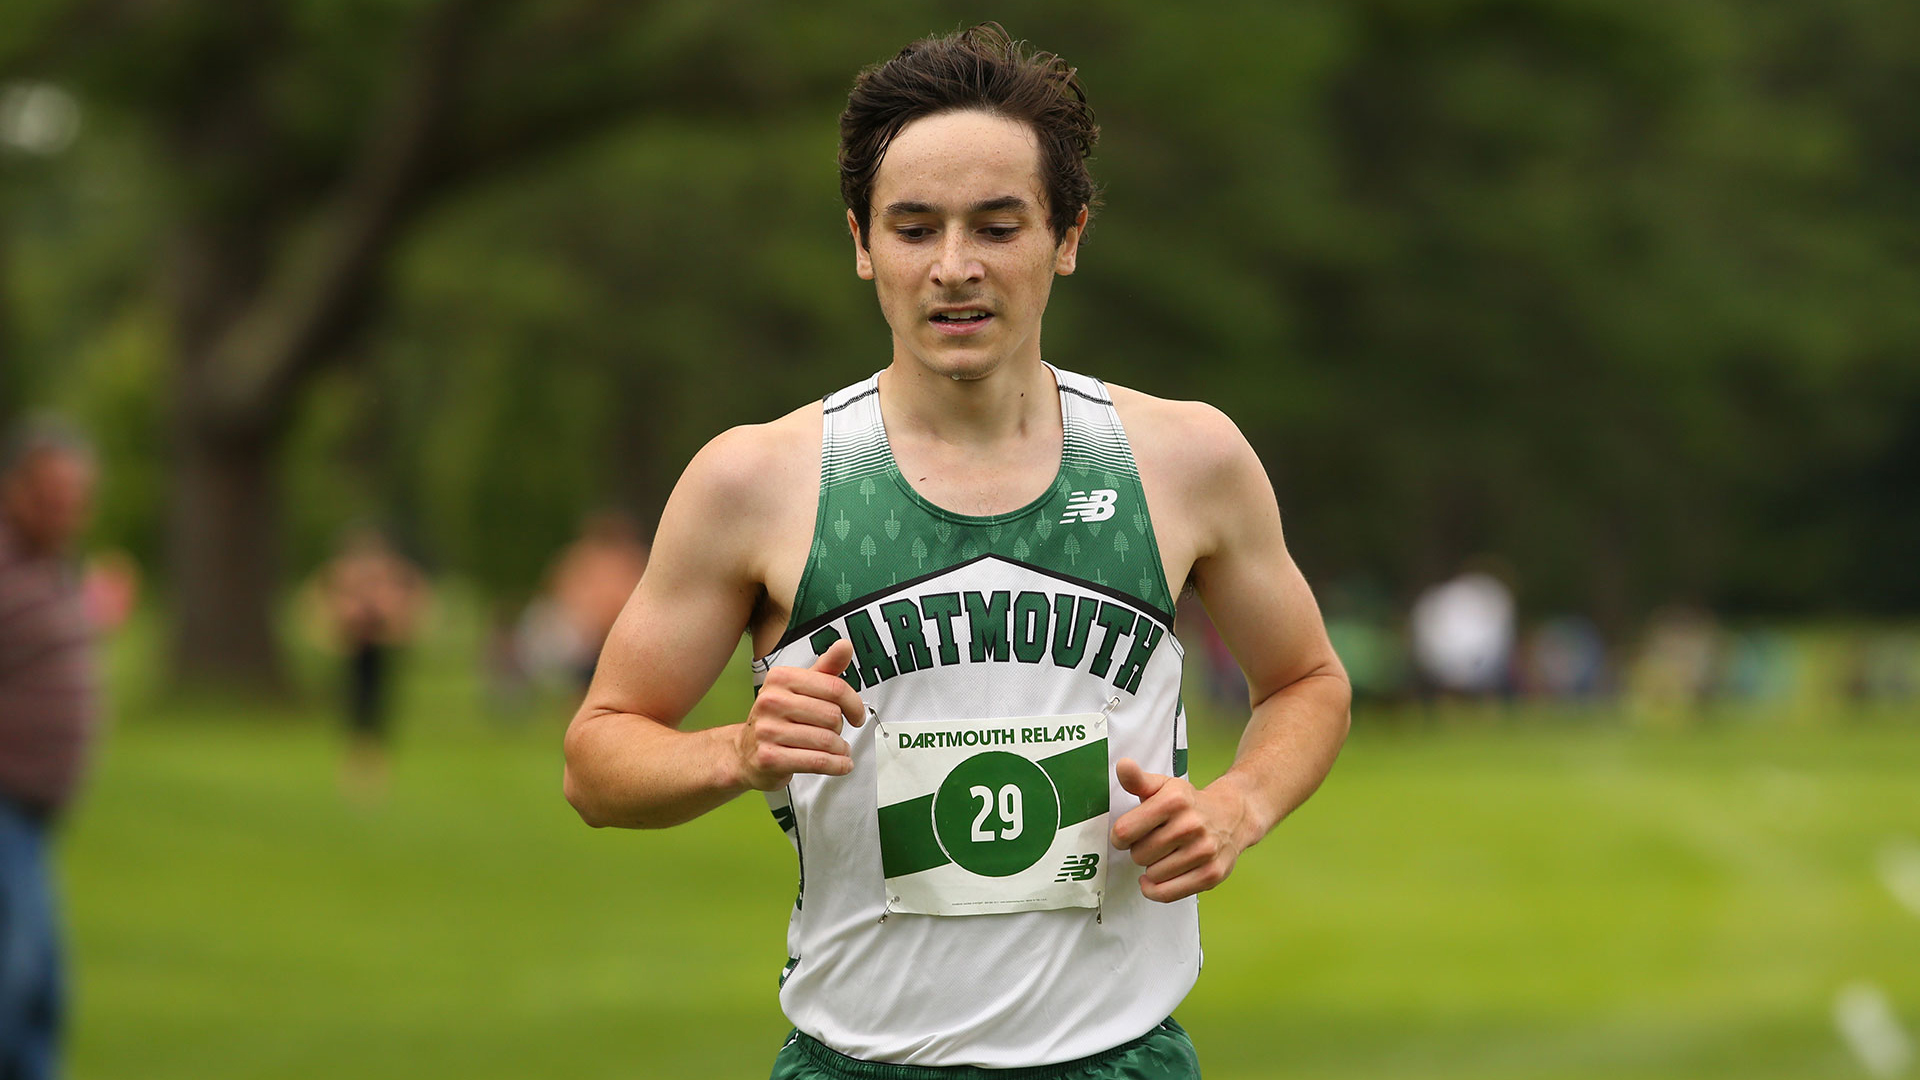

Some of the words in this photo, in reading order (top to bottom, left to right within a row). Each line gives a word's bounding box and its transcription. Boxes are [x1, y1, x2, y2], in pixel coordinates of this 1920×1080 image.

[898, 728, 1015, 749] DARTMOUTH
[1021, 724, 1087, 744] RELAYS
[969, 783, 1024, 842] 29
